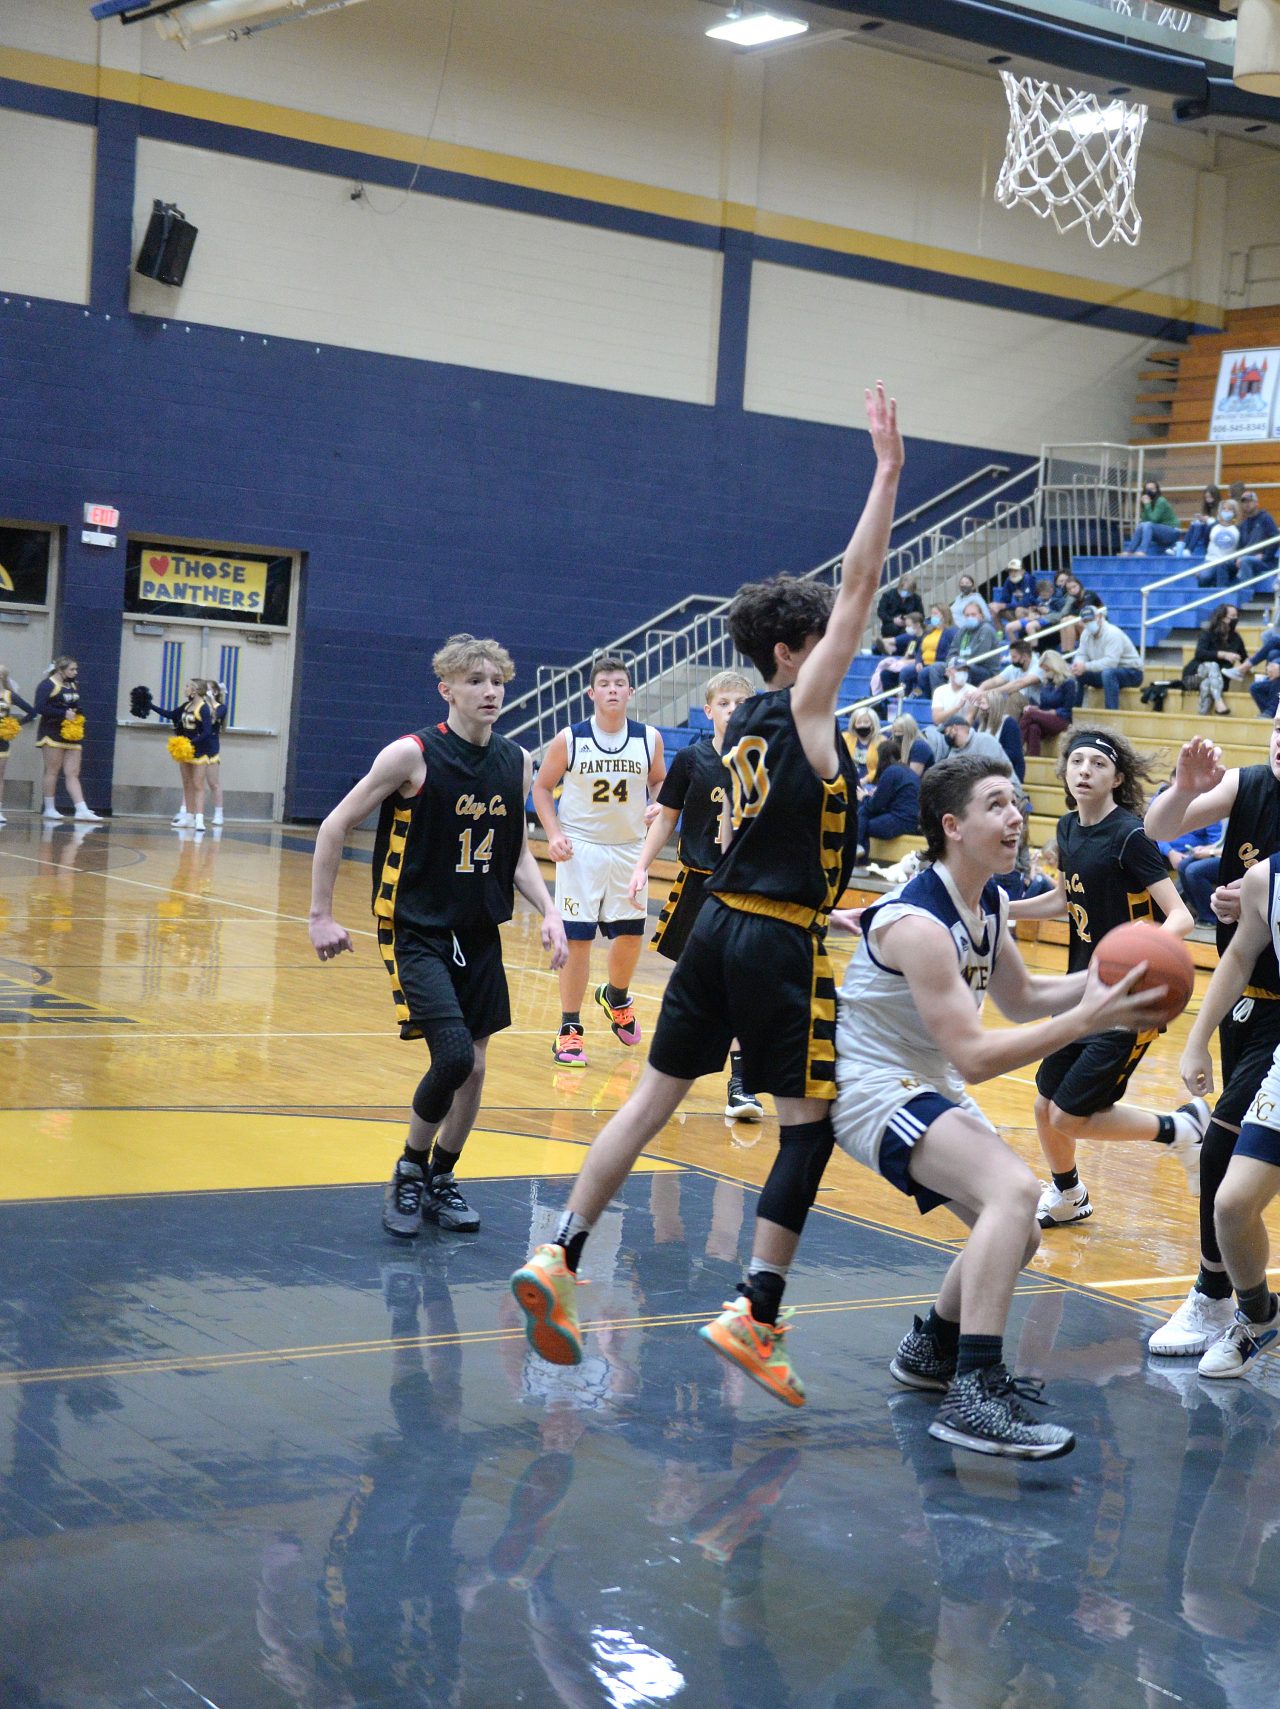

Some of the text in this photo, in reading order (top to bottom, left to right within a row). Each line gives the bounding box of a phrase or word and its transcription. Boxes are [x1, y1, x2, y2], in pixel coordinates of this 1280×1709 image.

[92, 507, 116, 525] EXIT
[171, 556, 246, 584] THOSE
[142, 580, 261, 609] PANTHERS
[579, 759, 642, 775] PANTHERS
[592, 779, 628, 803] 24
[455, 794, 487, 820] Clay
[455, 828, 495, 873] 14
[564, 898, 579, 916] KC
[1250, 1092, 1275, 1121] KC
